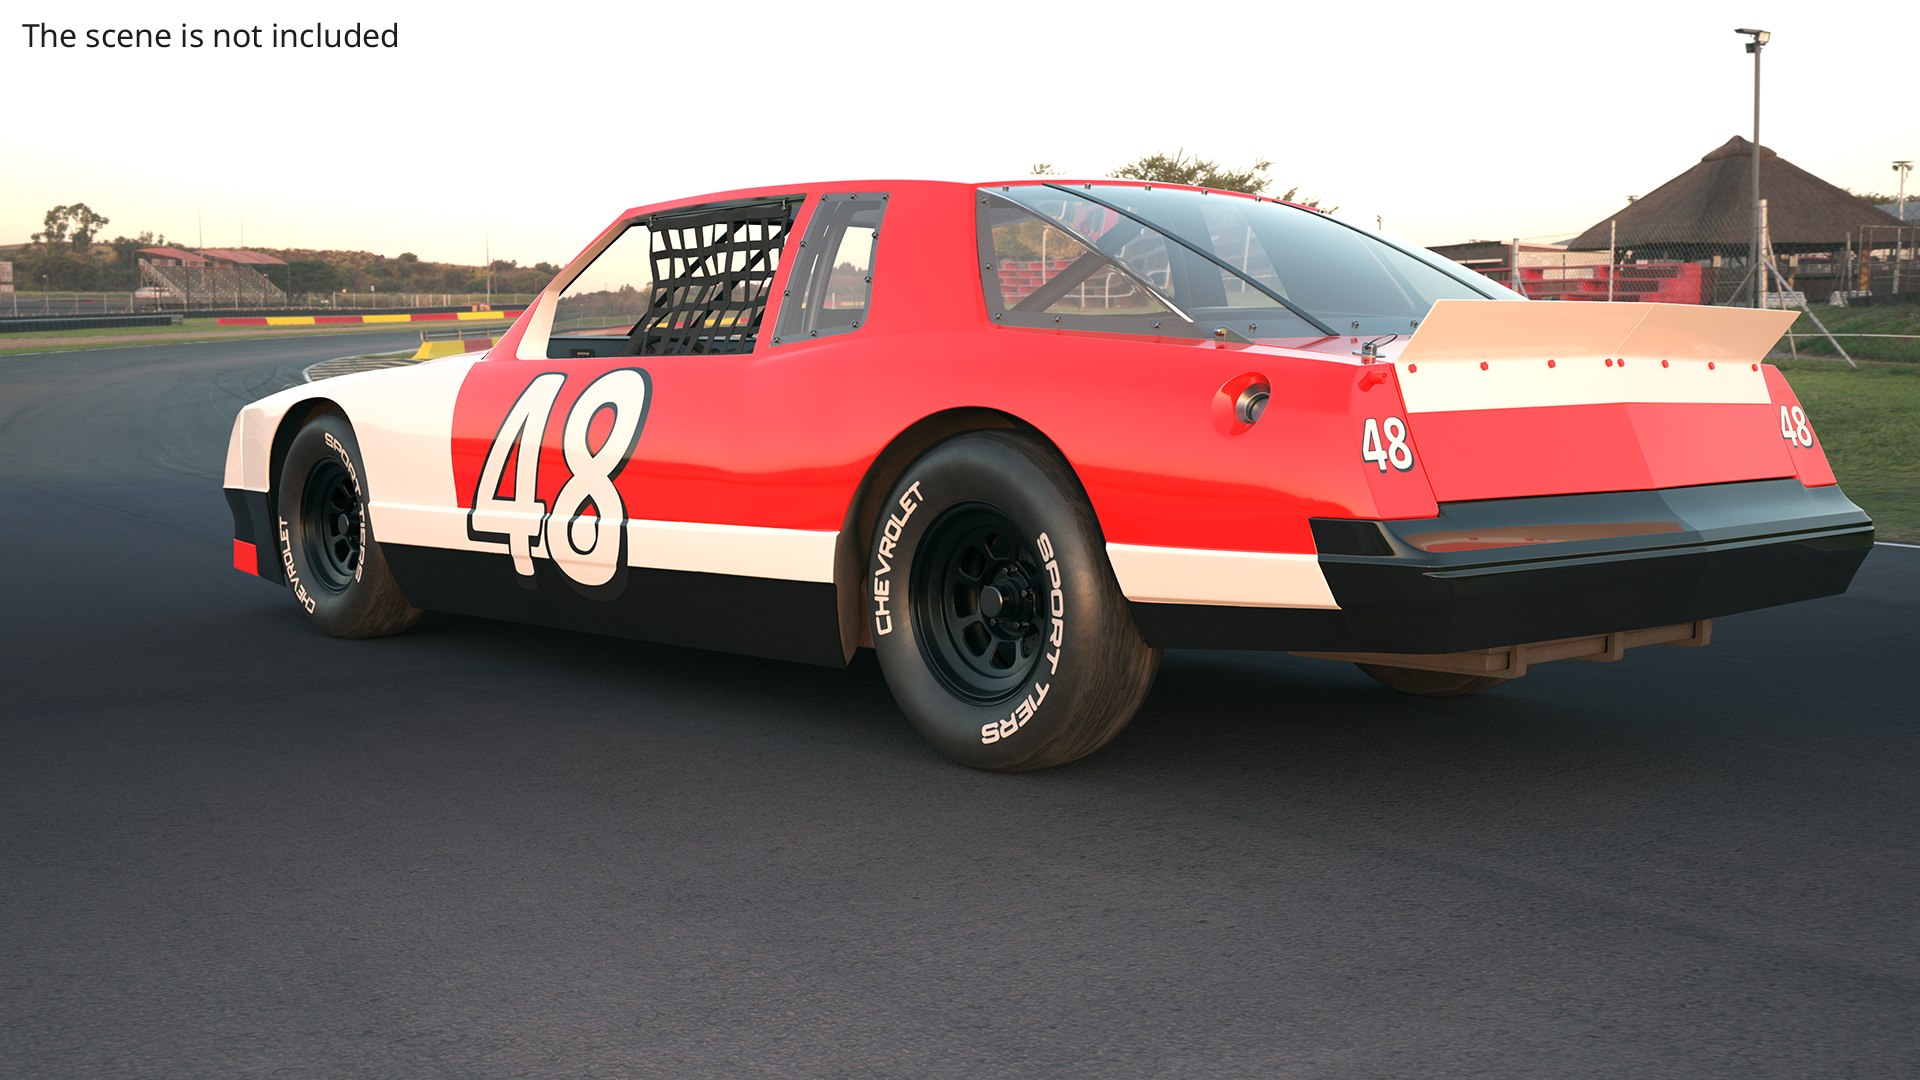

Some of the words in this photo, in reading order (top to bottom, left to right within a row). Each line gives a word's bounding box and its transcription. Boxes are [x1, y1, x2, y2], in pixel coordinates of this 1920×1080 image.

[324, 432, 362, 496] SPORT
[1362, 416, 1415, 474] 48
[1781, 405, 1814, 449] 48
[467, 367, 653, 592] 48
[279, 516, 317, 614] CHEVROLET
[874, 480, 924, 636] CHEVROLET
[1036, 532, 1064, 676] SPORT
[981, 682, 1050, 745] TIERS
